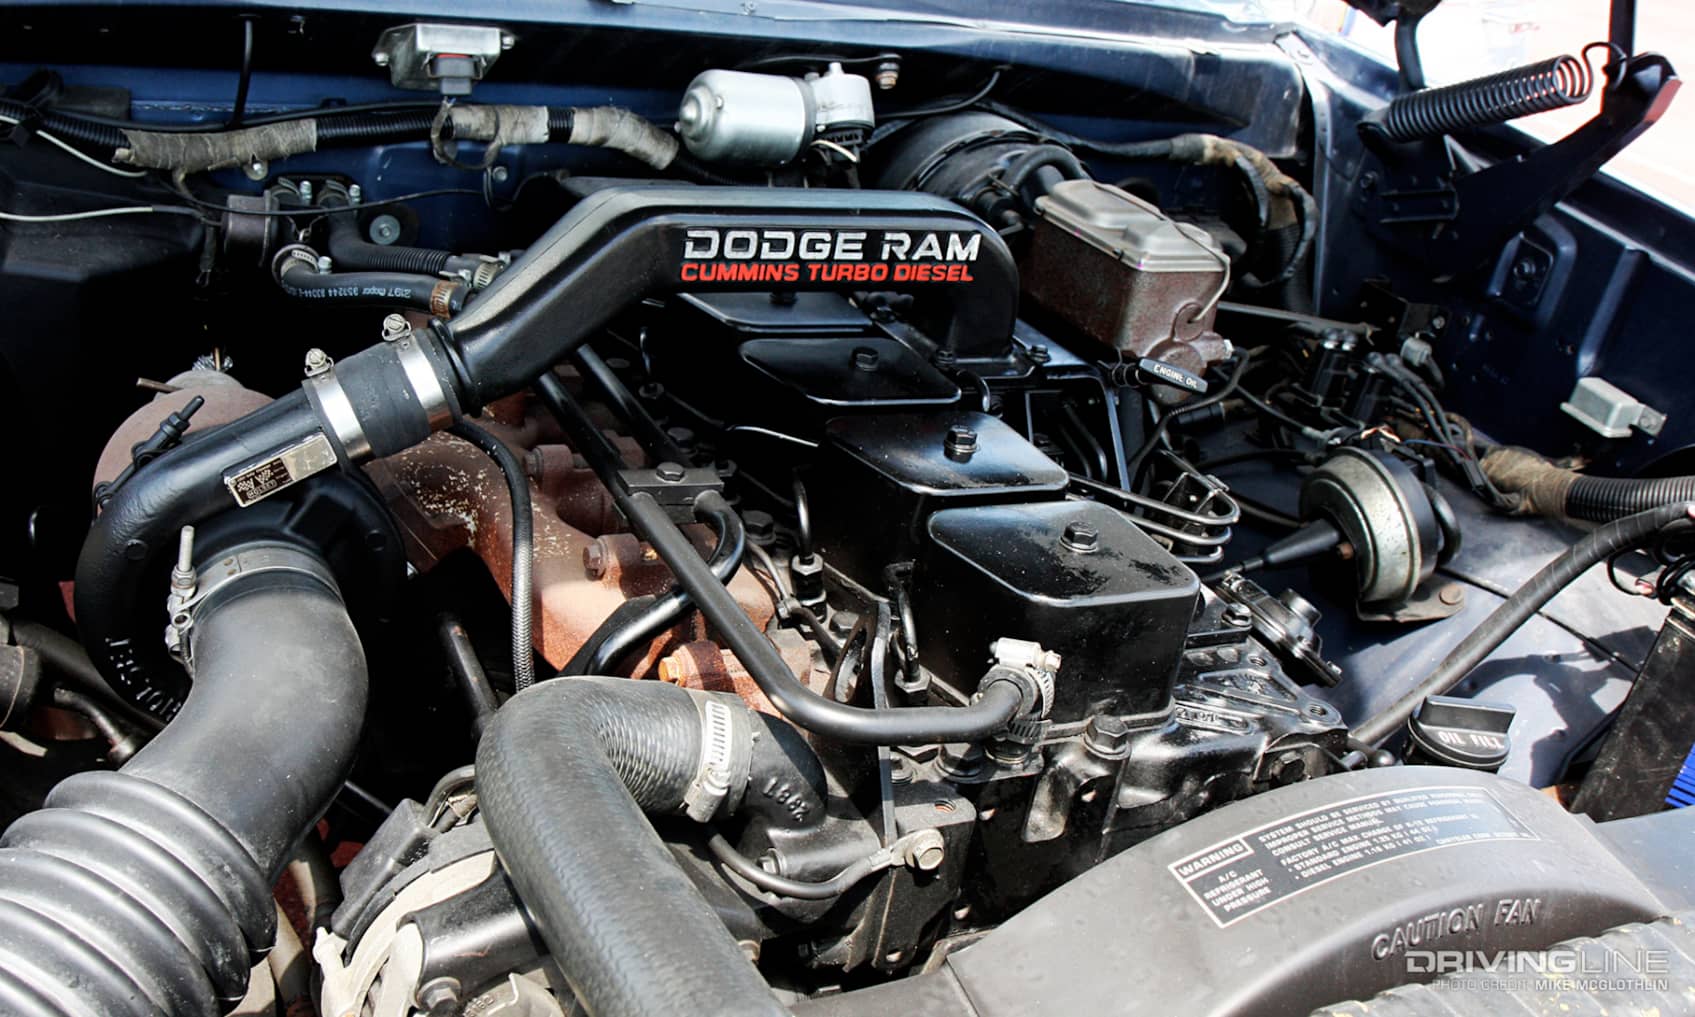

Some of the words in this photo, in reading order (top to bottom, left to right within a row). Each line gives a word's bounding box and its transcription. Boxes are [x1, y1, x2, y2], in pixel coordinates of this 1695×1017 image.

[683, 230, 868, 260] DODGE
[880, 231, 982, 262] RAM
[680, 263, 800, 282] CUMMINS
[807, 263, 889, 282] TURBO
[892, 263, 974, 282] DIESEL
[1153, 364, 1184, 383] ENGINE
[1438, 731, 1466, 745] OIL
[1470, 734, 1505, 750] FILL
[1258, 825, 1295, 842] SYSTEM
[1295, 814, 1329, 830] SHOULD
[1329, 811, 1342, 819] BE
[1264, 829, 1311, 850] IMPROPER
[1310, 819, 1345, 833] SERVICE
[1271, 838, 1312, 857] CONSULT
[1312, 826, 1348, 842] SERVICE
[1178, 842, 1245, 877] WARNING
[1280, 847, 1320, 867] FACTORY
[1321, 840, 1340, 852] A/C
[1293, 850, 1340, 871] STANDARD
[1340, 840, 1372, 854] ENGINE
[1300, 863, 1332, 878] DIESEL
[1332, 852, 1364, 867] ENGINE
[1203, 868, 1264, 900] REFRIGERANT
[1211, 888, 1246, 907] UNDER
[1246, 877, 1270, 892] HIGH
[1217, 870, 1239, 884] A/C
[1223, 886, 1272, 912] PRESSURE
[1371, 904, 1484, 961] CAUTION
[1493, 898, 1542, 927] FAN
